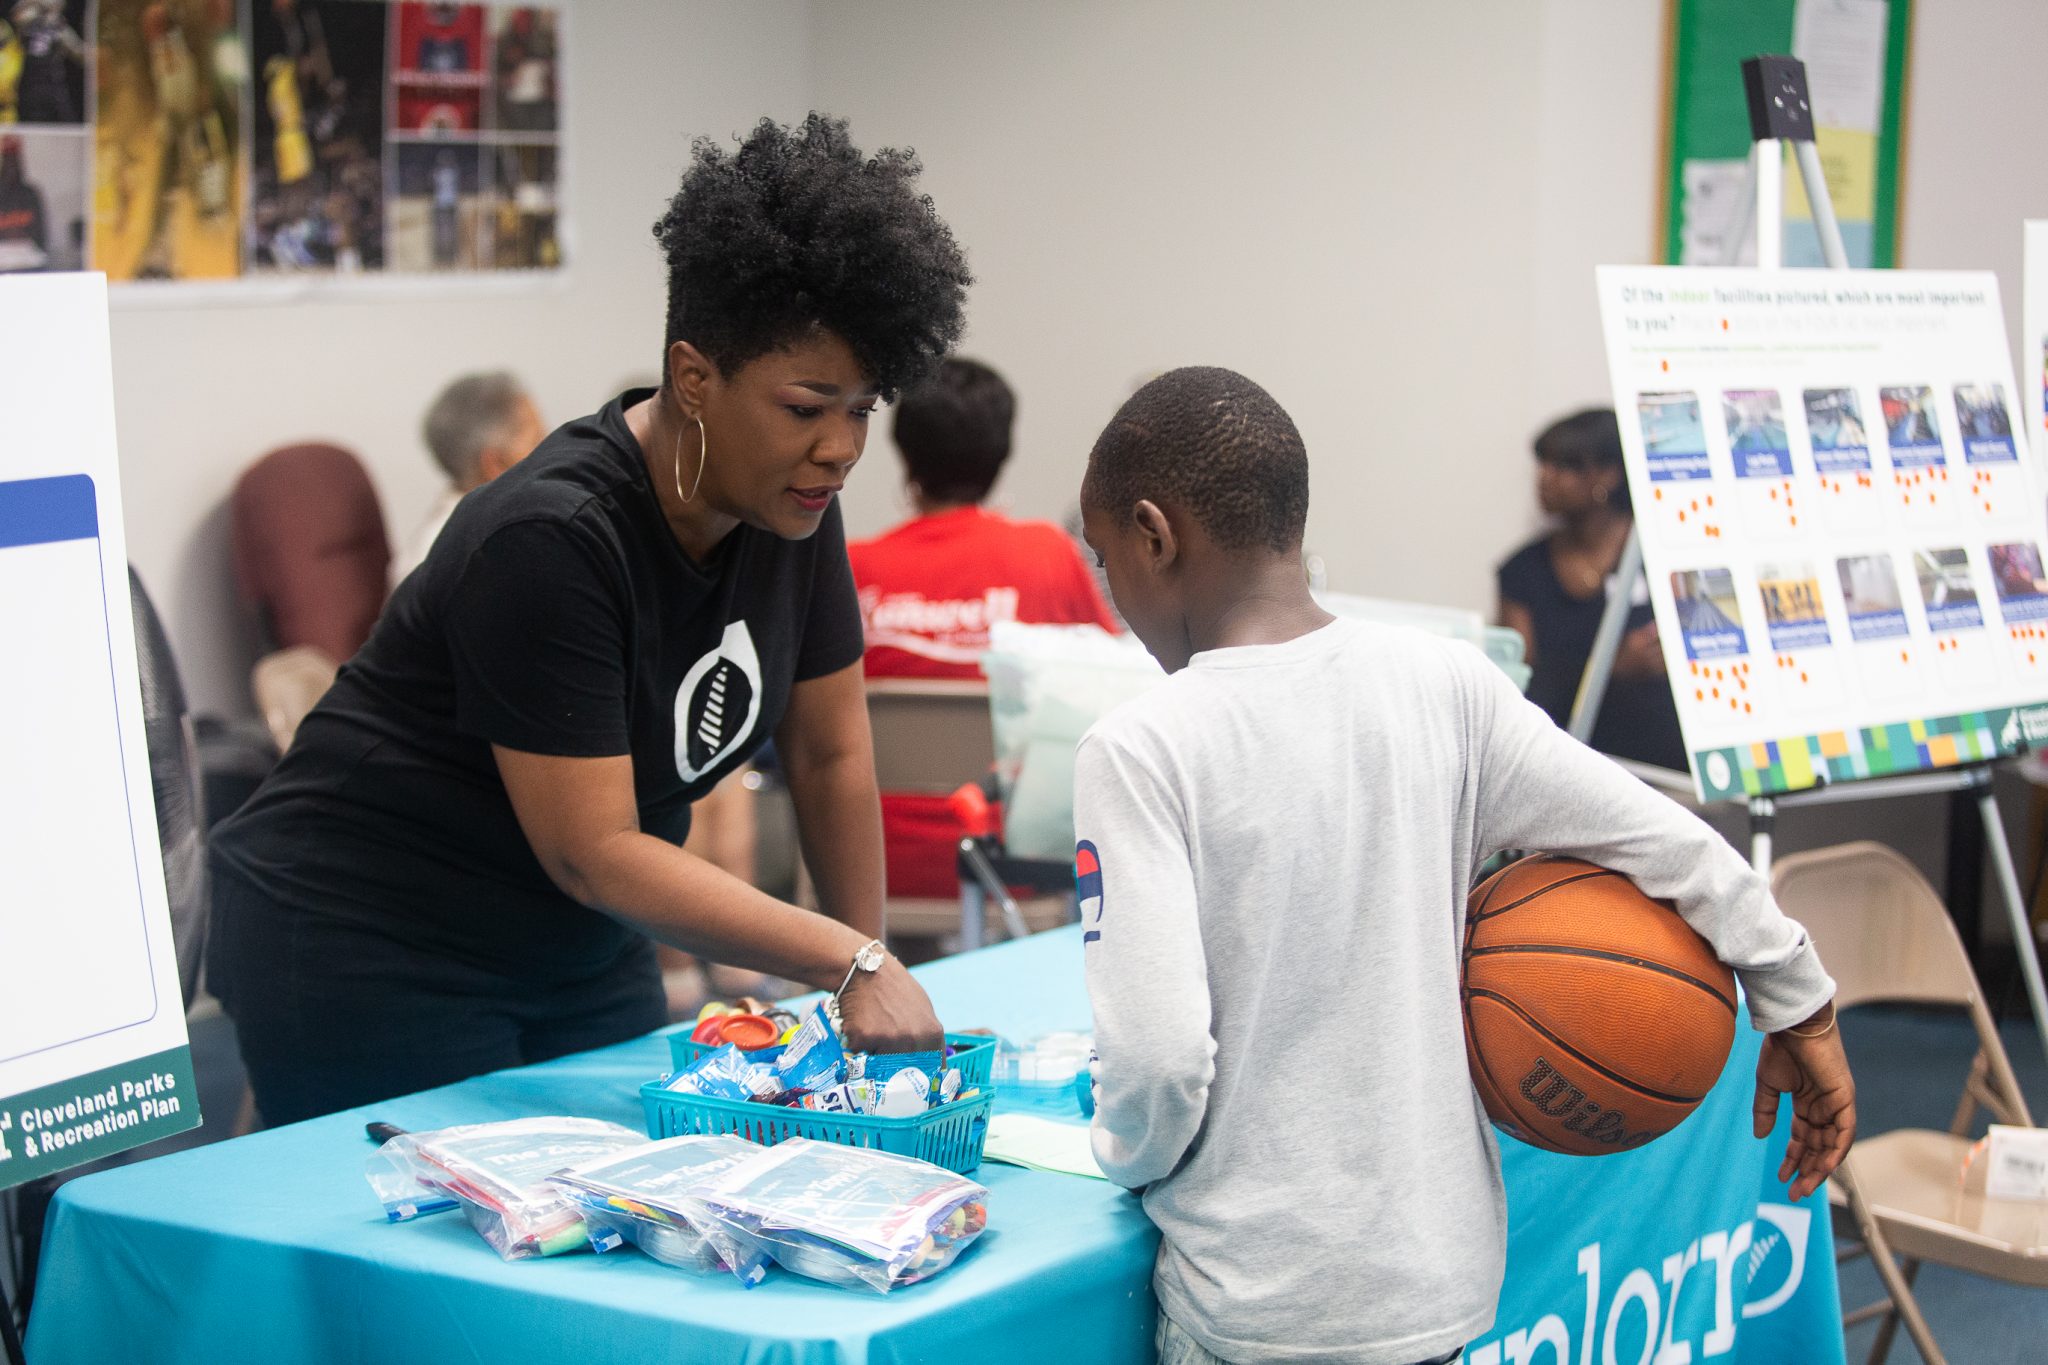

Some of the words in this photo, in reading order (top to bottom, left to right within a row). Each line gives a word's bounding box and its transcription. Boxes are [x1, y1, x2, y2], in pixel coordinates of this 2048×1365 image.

[20, 1085, 119, 1133] Cleveland
[121, 1072, 176, 1102] Parks
[24, 1135, 40, 1158] &
[40, 1108, 140, 1154] Recreation
[140, 1096, 181, 1122] Plan
